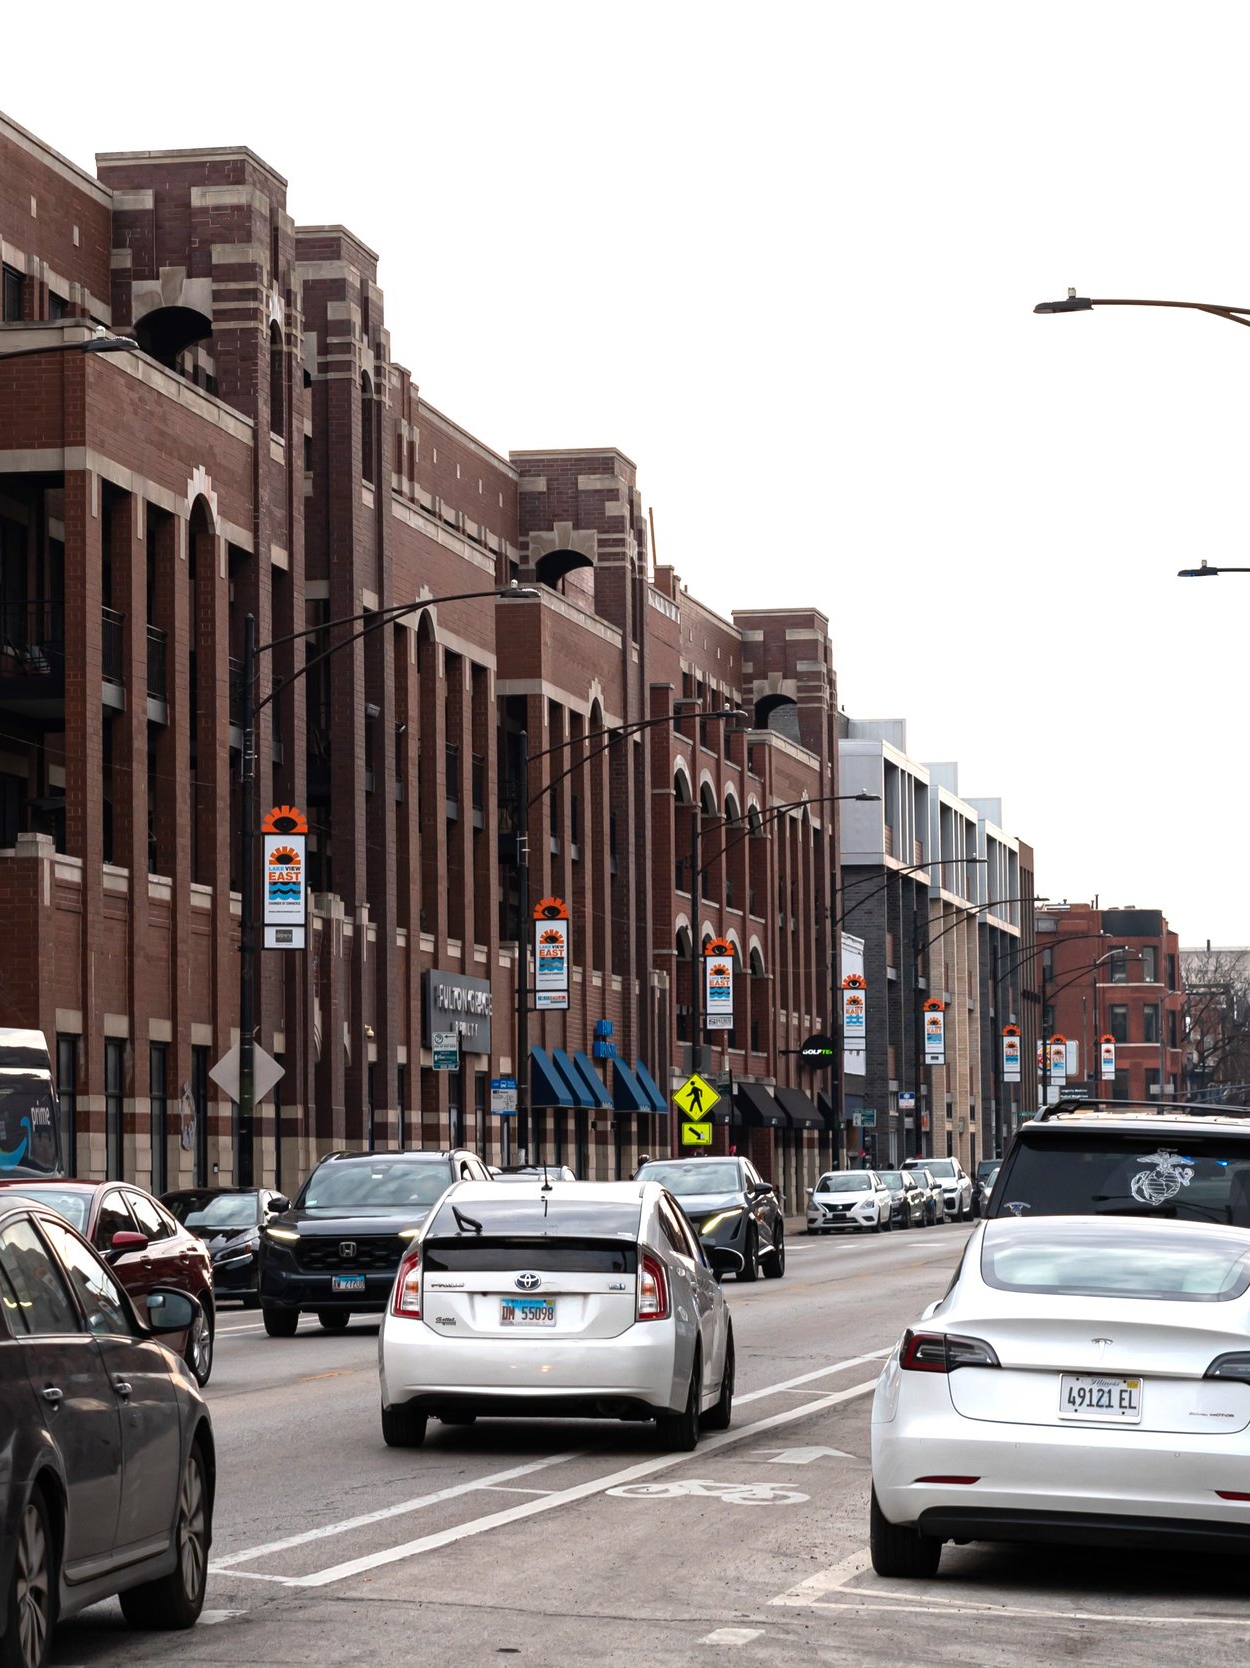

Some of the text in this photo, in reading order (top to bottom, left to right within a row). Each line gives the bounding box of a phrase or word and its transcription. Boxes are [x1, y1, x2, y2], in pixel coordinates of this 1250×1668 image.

[268, 872, 301, 881] EAST
[539, 949, 564, 957] EAST
[439, 984, 493, 1016] FULTON GRACE
[31, 1100, 50, 1132] prime
[521, 1306, 554, 1321] 55098
[1090, 1378, 1120, 1387] Illinois
[1067, 1386, 1137, 1410] 49121 EL
